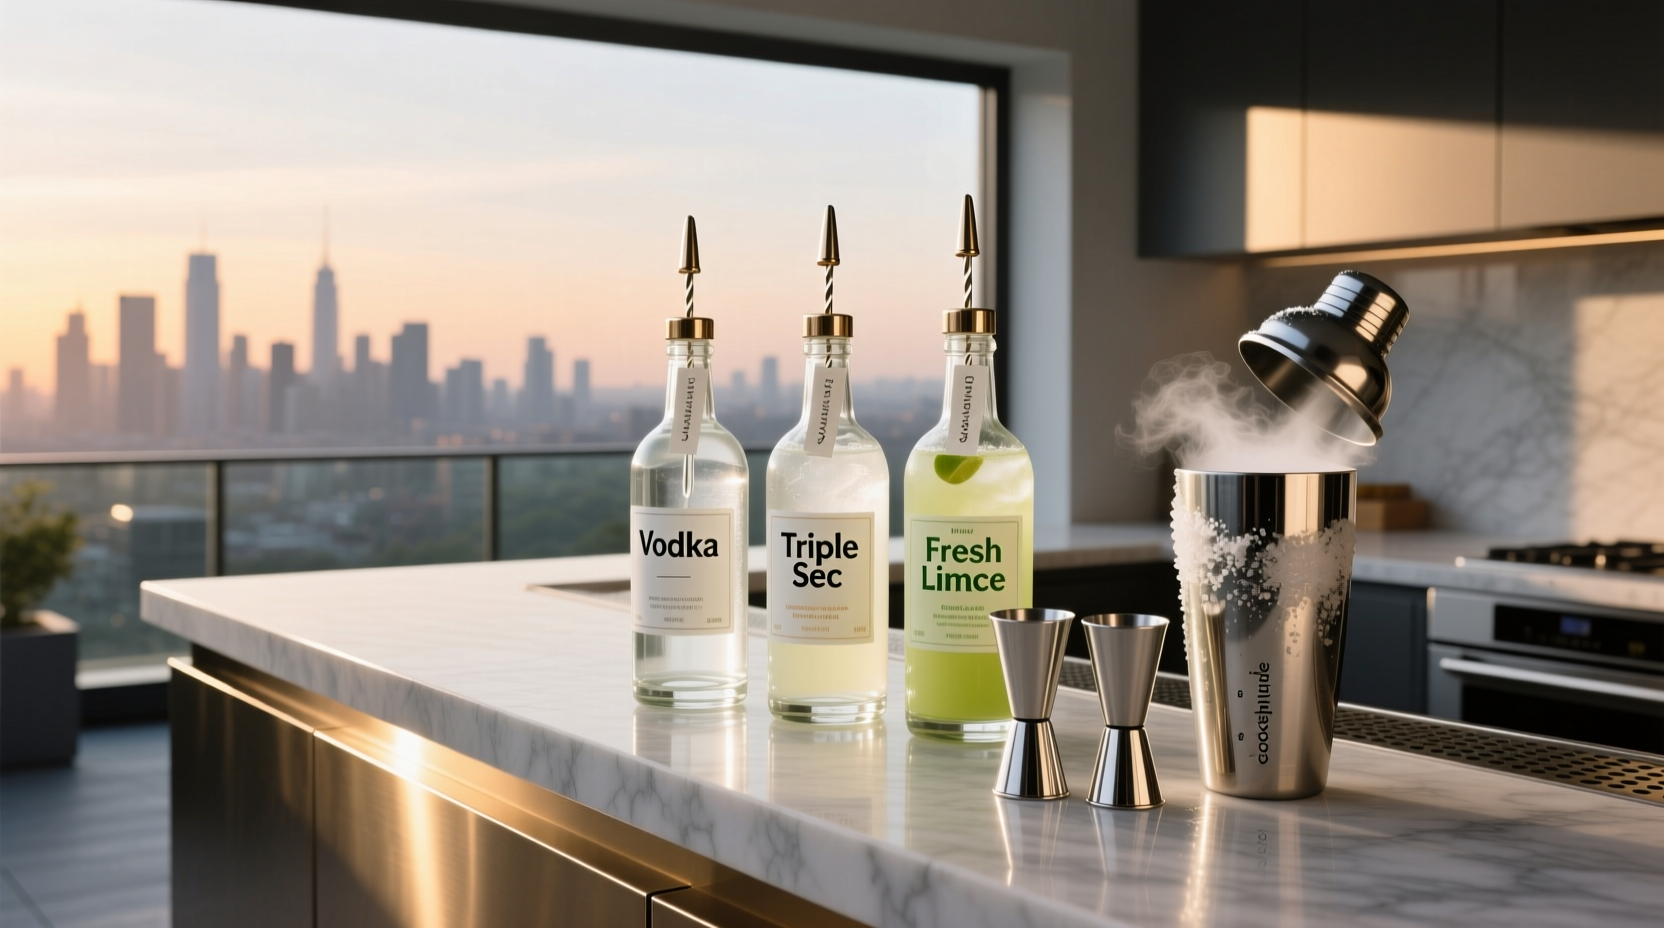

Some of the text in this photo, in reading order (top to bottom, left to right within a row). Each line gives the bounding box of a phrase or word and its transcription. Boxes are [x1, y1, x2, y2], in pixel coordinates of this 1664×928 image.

[639, 529, 719, 558] Vodka
[781, 531, 859, 567] Triple
[926, 536, 1002, 564] Fresh
[792, 561, 842, 588] Sec
[922, 565, 1006, 592] Limce
